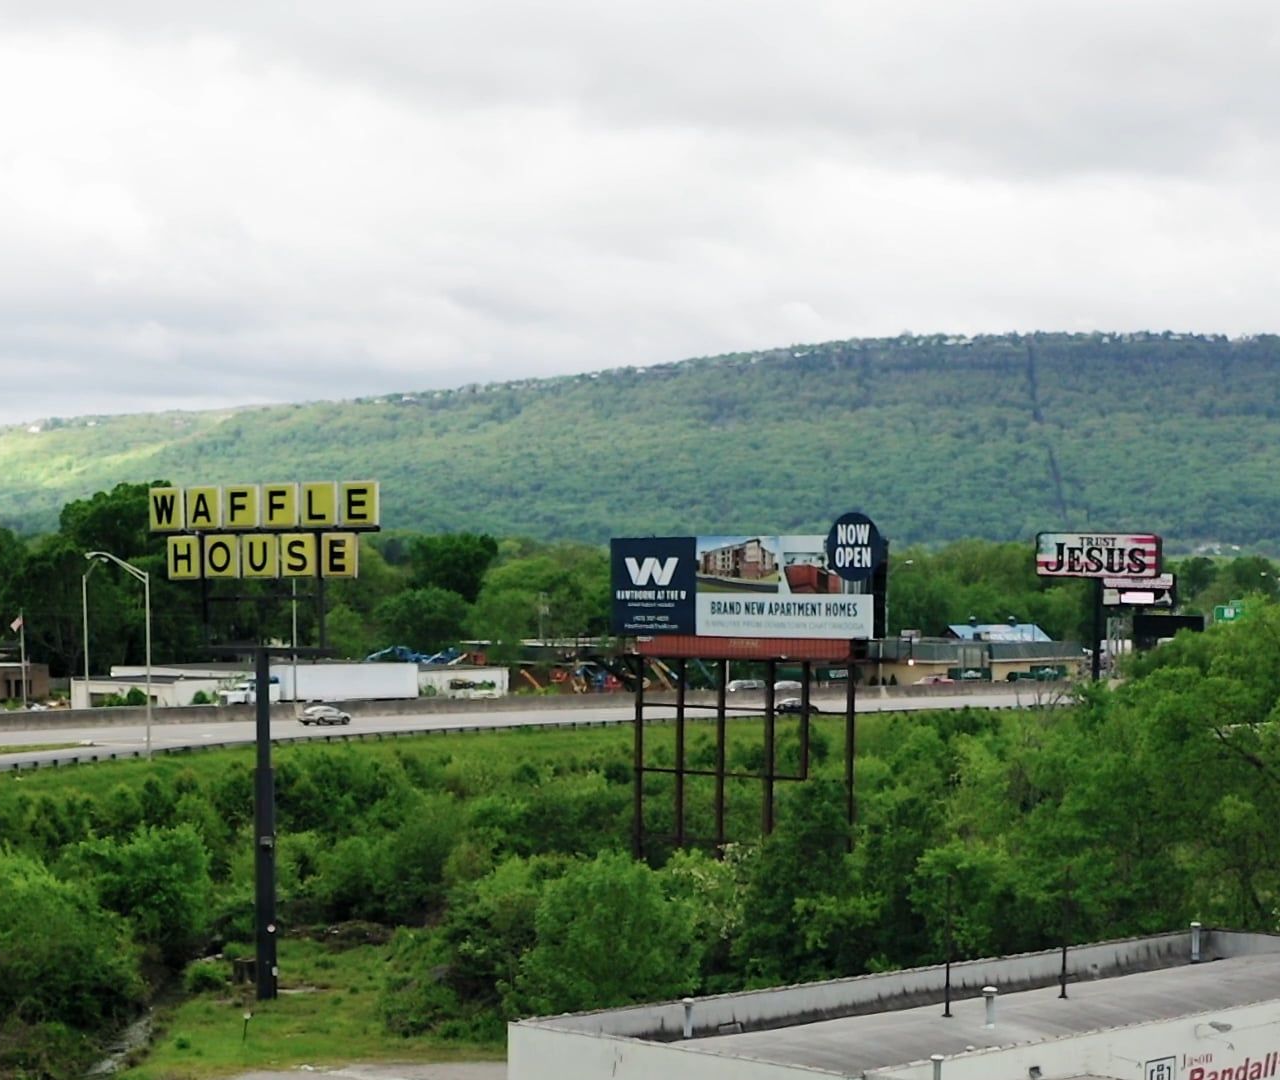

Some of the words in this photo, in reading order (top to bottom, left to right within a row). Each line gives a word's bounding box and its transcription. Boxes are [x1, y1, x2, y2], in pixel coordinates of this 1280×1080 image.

[153, 488, 368, 525] WAFFLE
[837, 524, 870, 545] NOW
[1079, 536, 1117, 547] TRUST
[173, 539, 346, 573] HOUSE
[835, 547, 872, 568] OPEN
[1044, 542, 1147, 574] JESUS
[710, 601, 741, 615] BRAND
[745, 602, 765, 616] NEW
[769, 603, 822, 617] APARTMENT
[825, 603, 858, 617] HOMES
